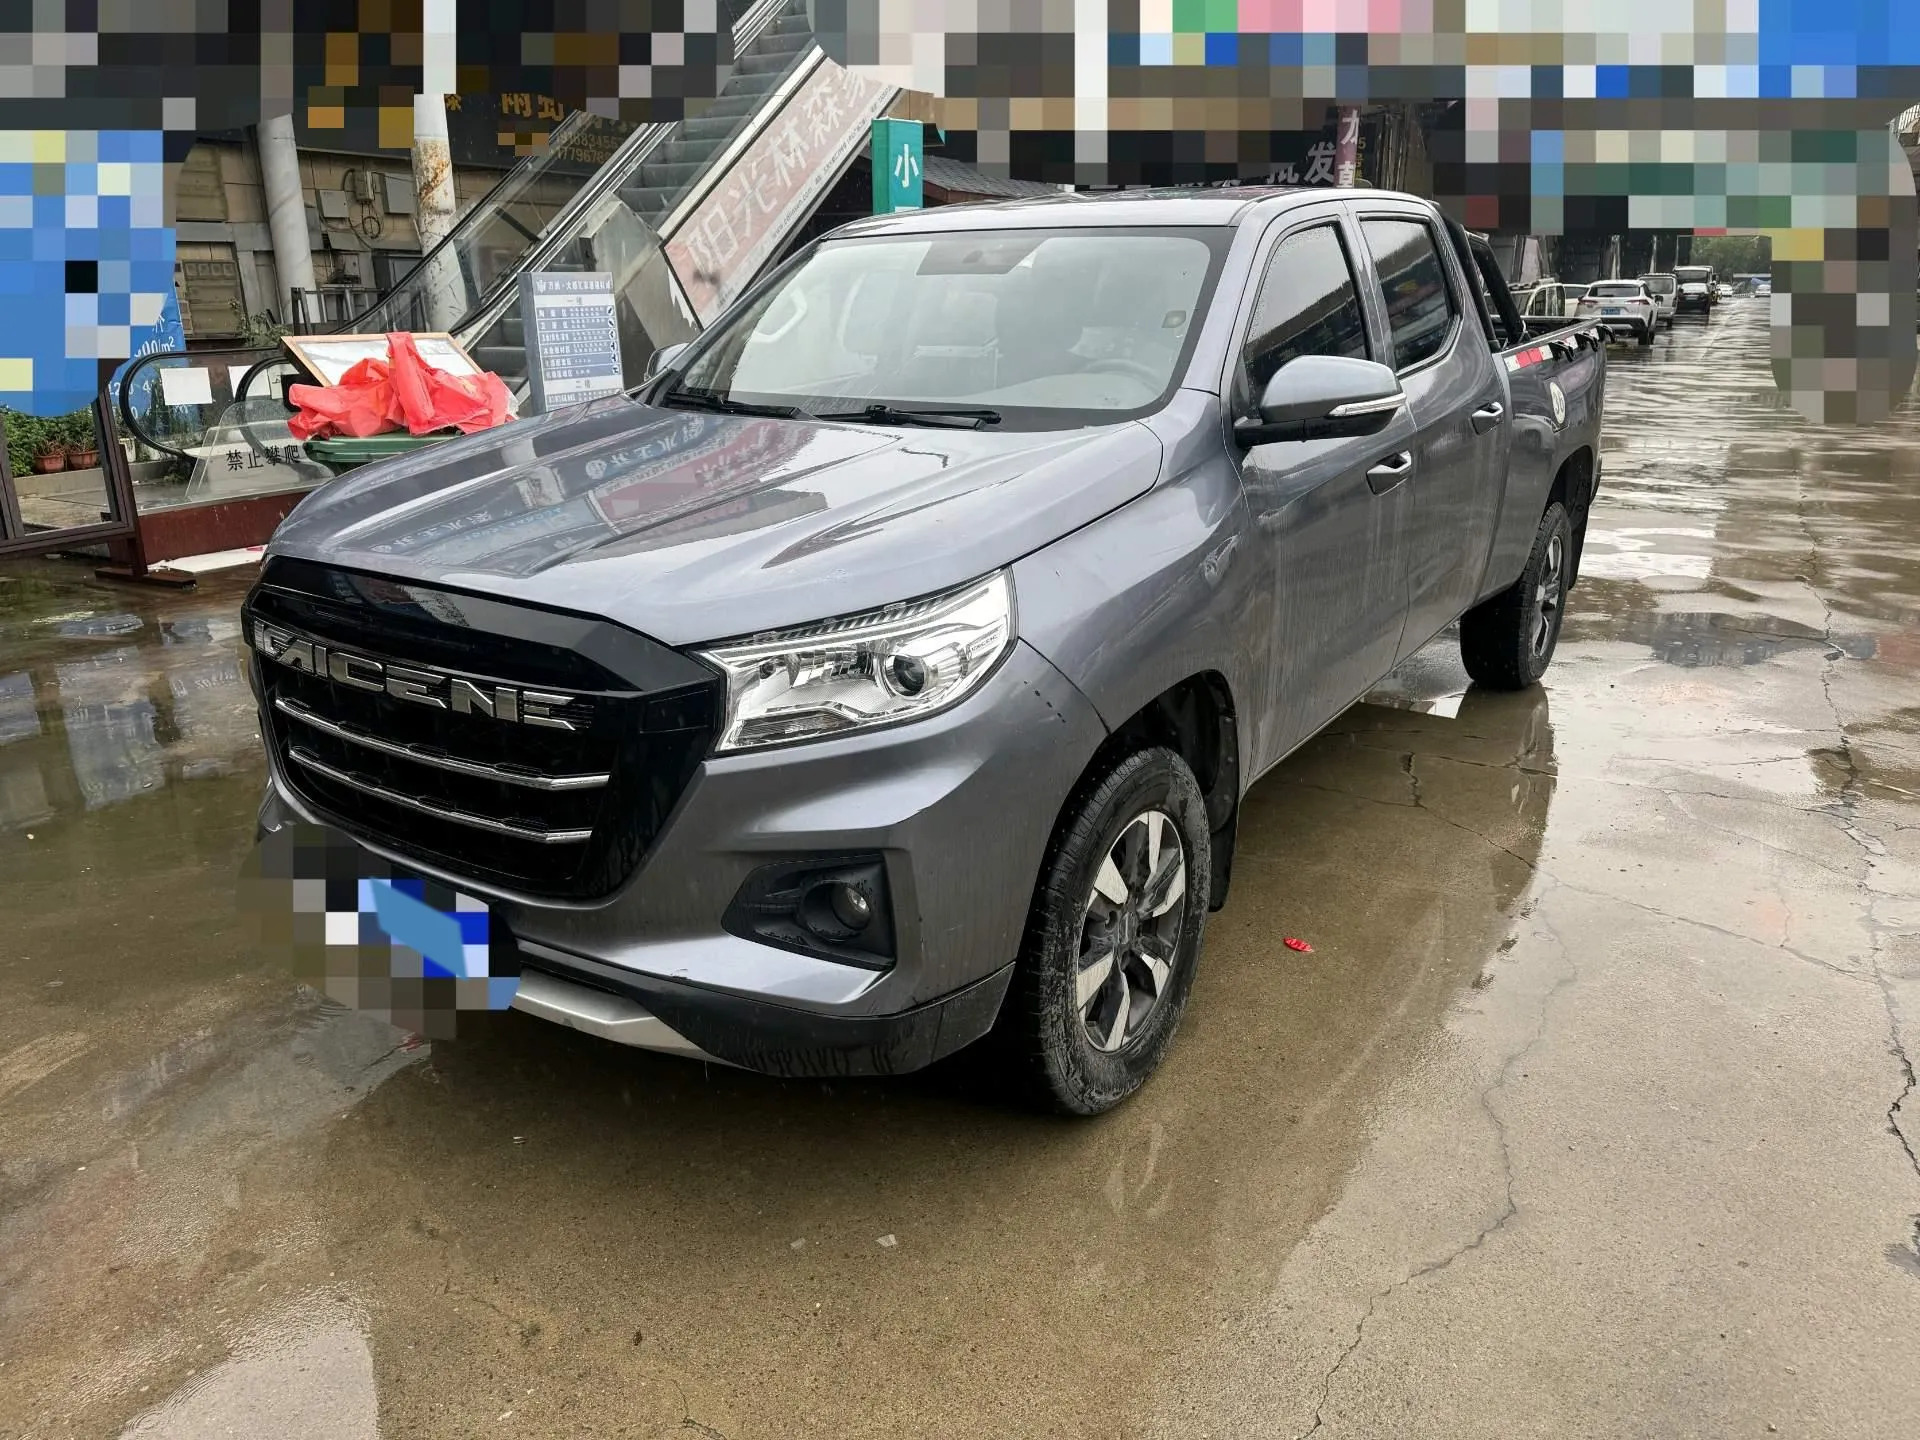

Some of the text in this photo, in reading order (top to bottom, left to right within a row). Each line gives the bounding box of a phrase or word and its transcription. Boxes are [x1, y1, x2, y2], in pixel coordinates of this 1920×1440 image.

[894, 143, 920, 212] 小
[226, 444, 301, 472] 禁止攀爬
